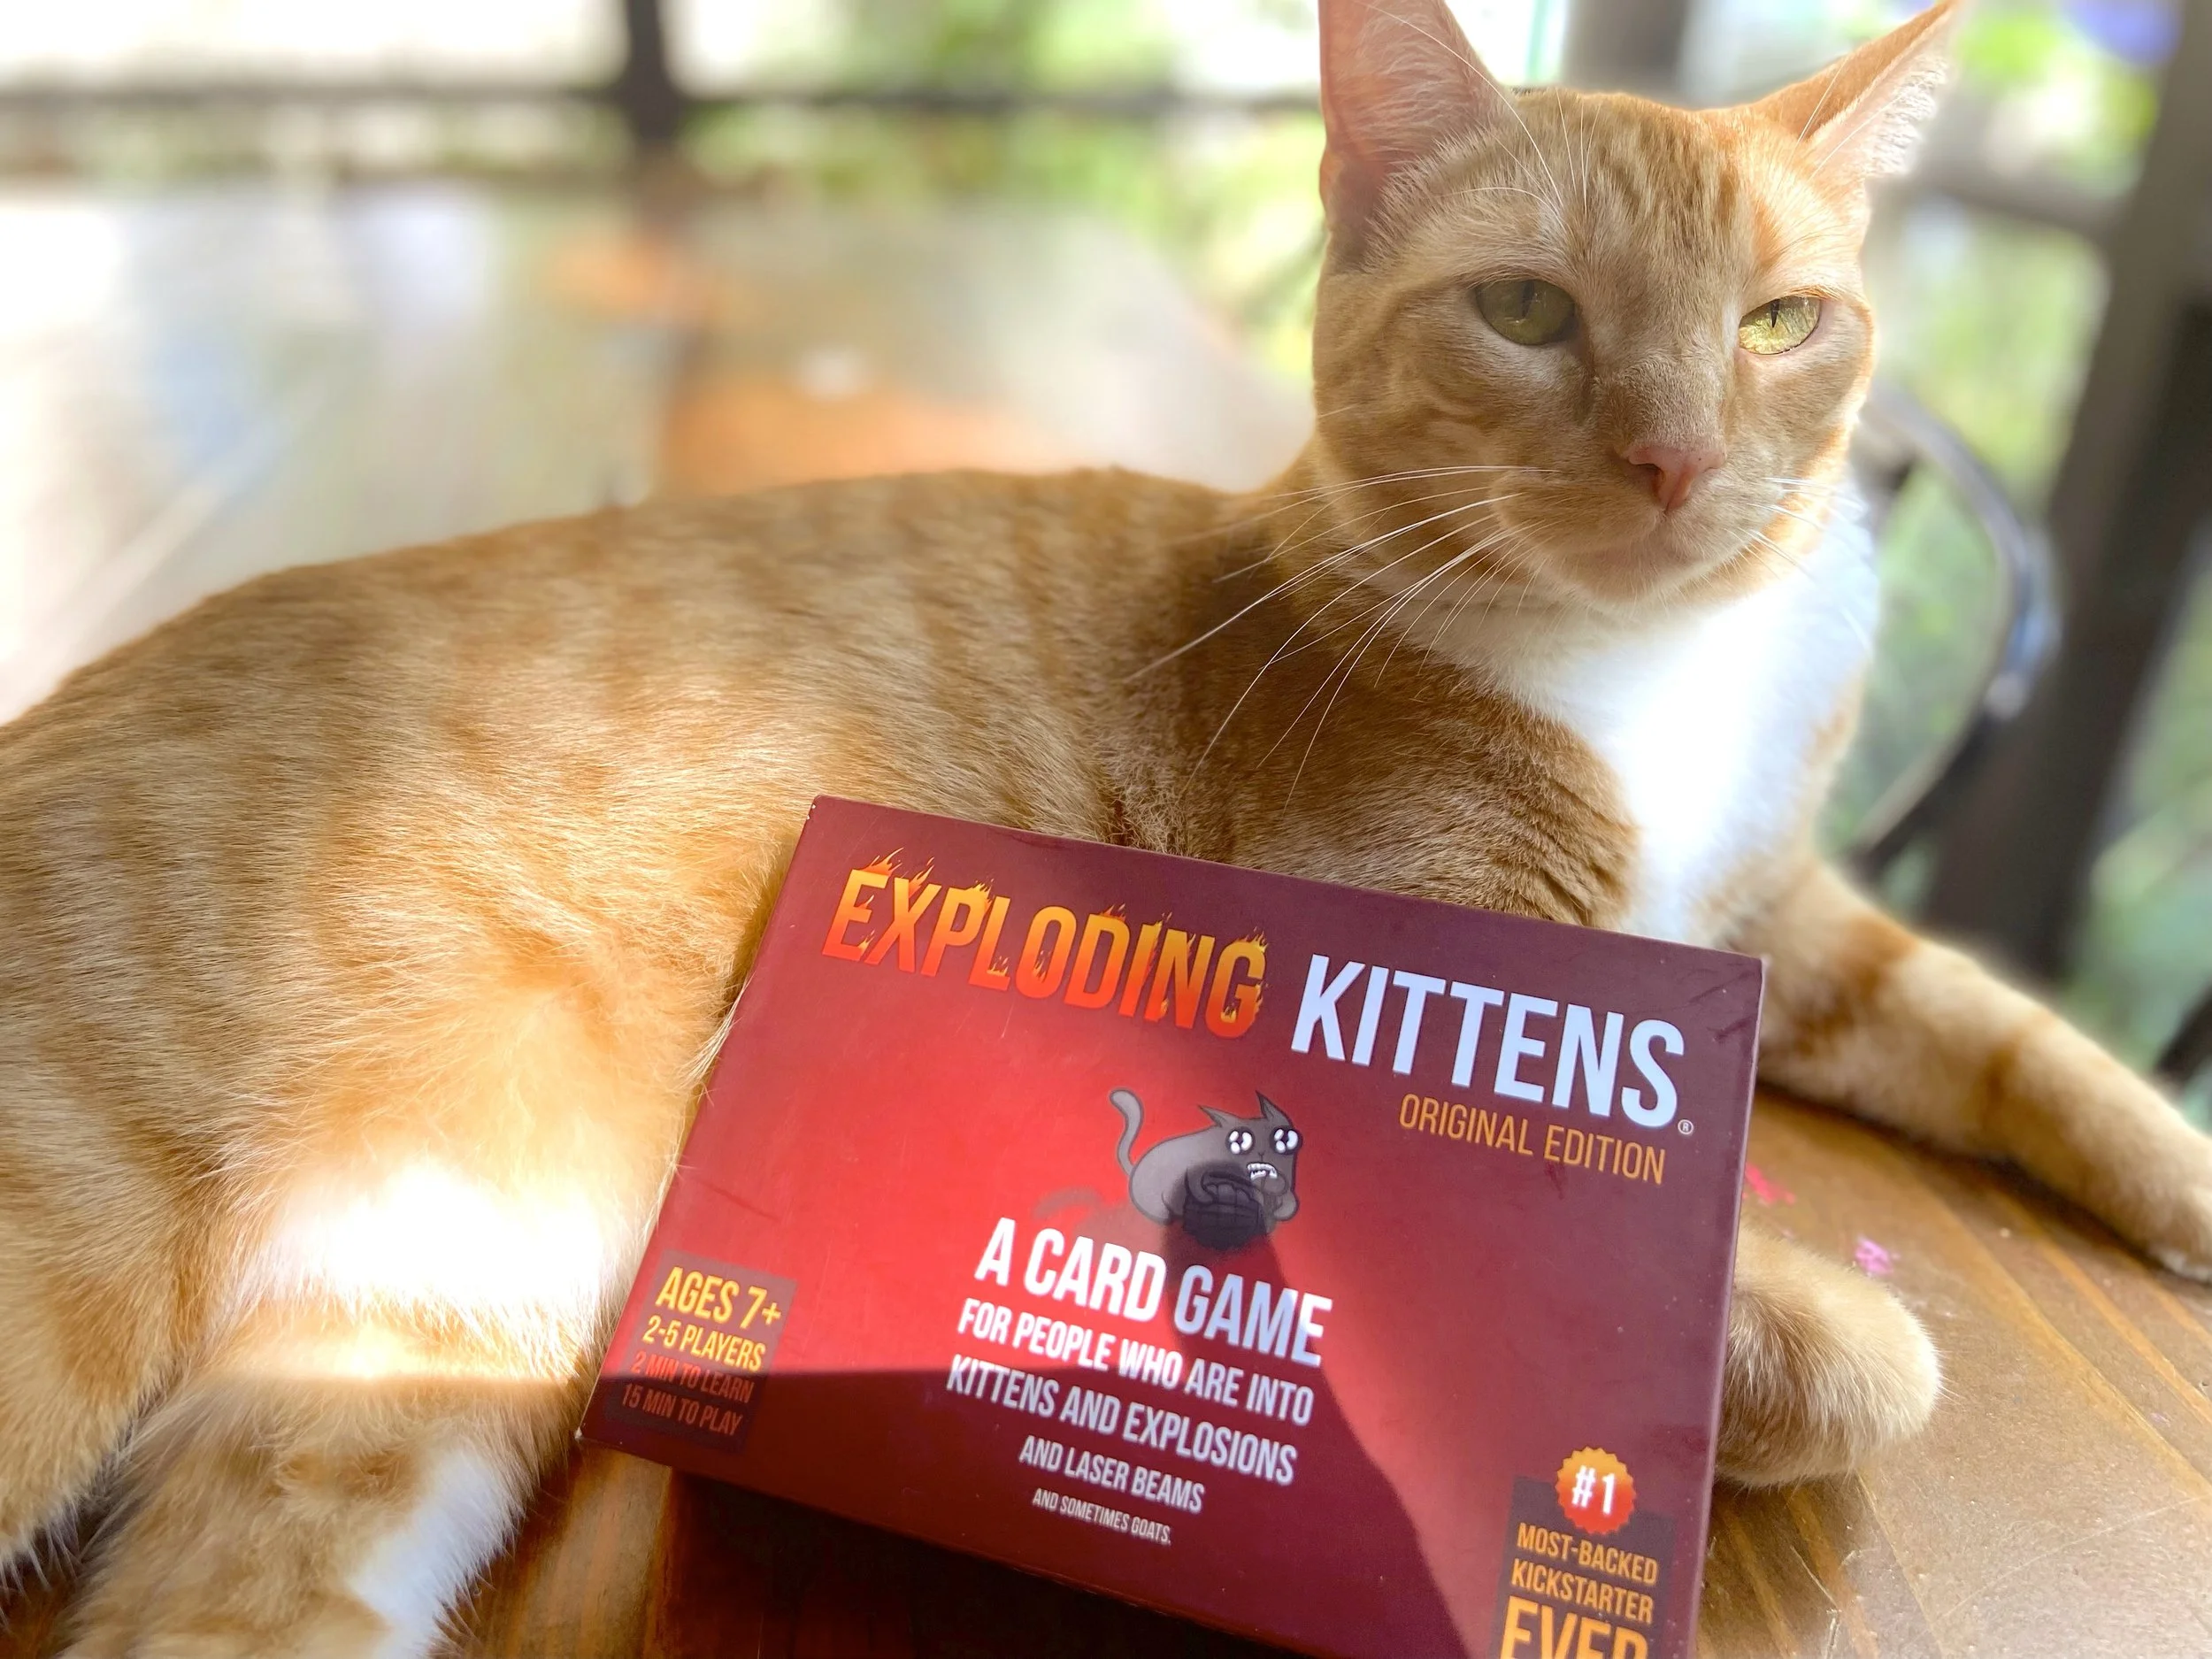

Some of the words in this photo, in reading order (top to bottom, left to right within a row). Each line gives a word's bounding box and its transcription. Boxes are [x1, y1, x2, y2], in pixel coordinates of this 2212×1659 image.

[822, 858, 1269, 1038] EXPLODING
[1399, 1094, 1533, 1156] ORIGINAL
[1544, 1125, 1665, 1185] EDITION
[656, 1266, 740, 1323] AGES
[740, 1286, 781, 1329] 7+
[975, 1217, 1016, 1286] A
[1024, 1228, 1167, 1322] CARD
[1174, 1264, 1333, 1368] GAME
[642, 1316, 681, 1348] 2-5
[680, 1325, 766, 1371] PLAYERS
[957, 1298, 1014, 1342] FOR
[1013, 1311, 1116, 1371] PEOPLE
[1118, 1338, 1183, 1390] WHO
[1185, 1358, 1244, 1407] ARE
[1246, 1374, 1314, 1426] INTO
[631, 1350, 647, 1374] 2
[645, 1354, 679, 1382] MIN
[680, 1363, 702, 1389] TO
[701, 1370, 755, 1403] LEARN
[622, 1383, 643, 1409] 15
[642, 1389, 677, 1418] MIN
[678, 1398, 699, 1425] TO
[699, 1405, 742, 1435] PLAY
[947, 1355, 1059, 1417] KITTENS
[1060, 1386, 1121, 1434] AND
[1122, 1403, 1297, 1486] EXPLOSIONS
[1019, 1435, 1063, 1471] AND
[1064, 1448, 1130, 1493] LASER
[1131, 1466, 1205, 1513] BEAMS
[1571, 1464, 1616, 1515] #1
[1033, 1488, 1059, 1510] AND
[1060, 1495, 1130, 1532] SOMETIMES
[1131, 1516, 1171, 1546] GOATS.
[1517, 1523, 1658, 1586] MOST-BACKED
[1510, 1559, 1655, 1624] KICKSTARTER
